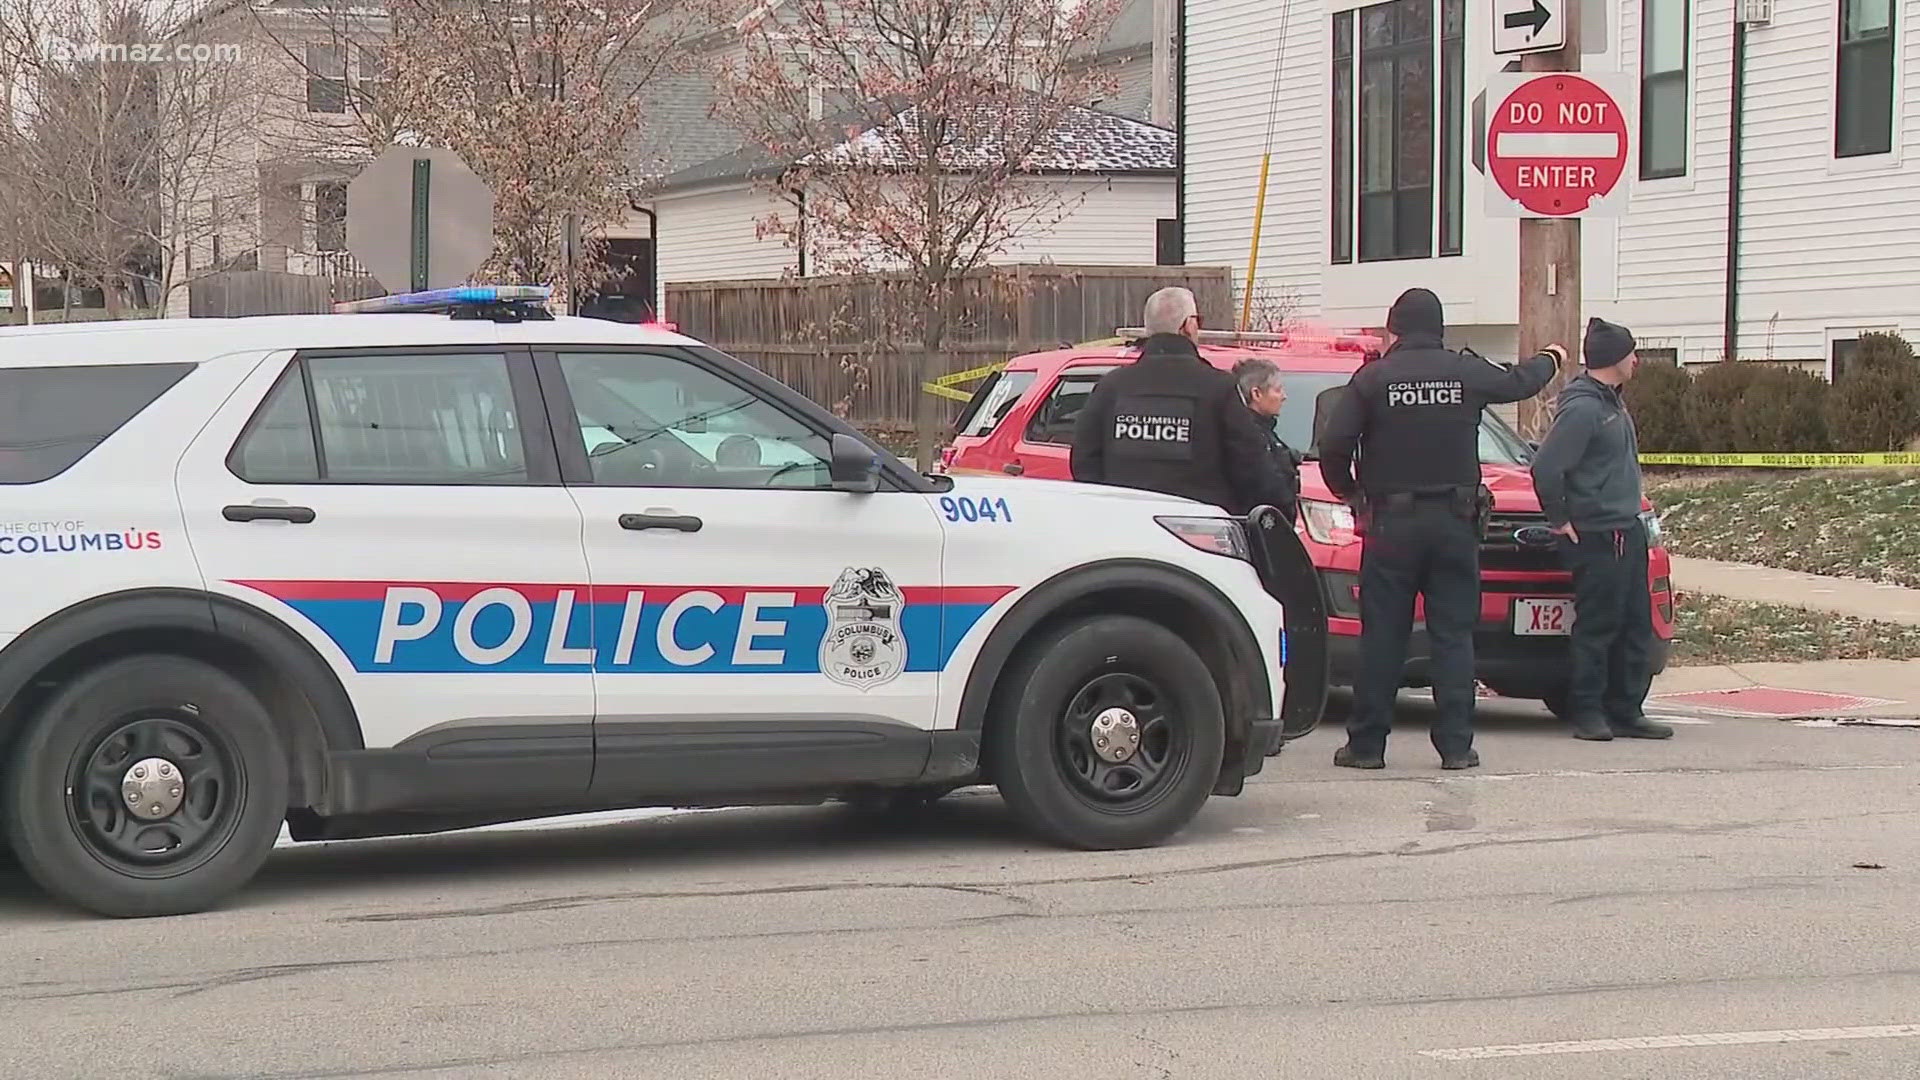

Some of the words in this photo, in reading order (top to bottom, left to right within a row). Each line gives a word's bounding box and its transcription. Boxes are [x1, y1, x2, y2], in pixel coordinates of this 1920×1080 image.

[1510, 102, 1543, 124] DO
[1559, 102, 1608, 124] NOT
[1518, 166, 1596, 188] ENTER
[1388, 381, 1462, 391] COLUMBUS
[1388, 389, 1462, 407] POLICE
[1116, 415, 1190, 426] COLUMBUS
[1115, 423, 1190, 442] POLICE
[940, 497, 1012, 522] 9041
[0, 522, 24, 534] HE
[28, 521, 60, 533] CITY
[64, 520, 85, 531] OF
[0, 530, 161, 554] COLUMBUS
[373, 586, 797, 666] POLICE
[1530, 605, 1542, 630] X
[1551, 605, 1563, 630] 2
[837, 625, 889, 639] COLUMBUS
[843, 667, 881, 679] POLICE
